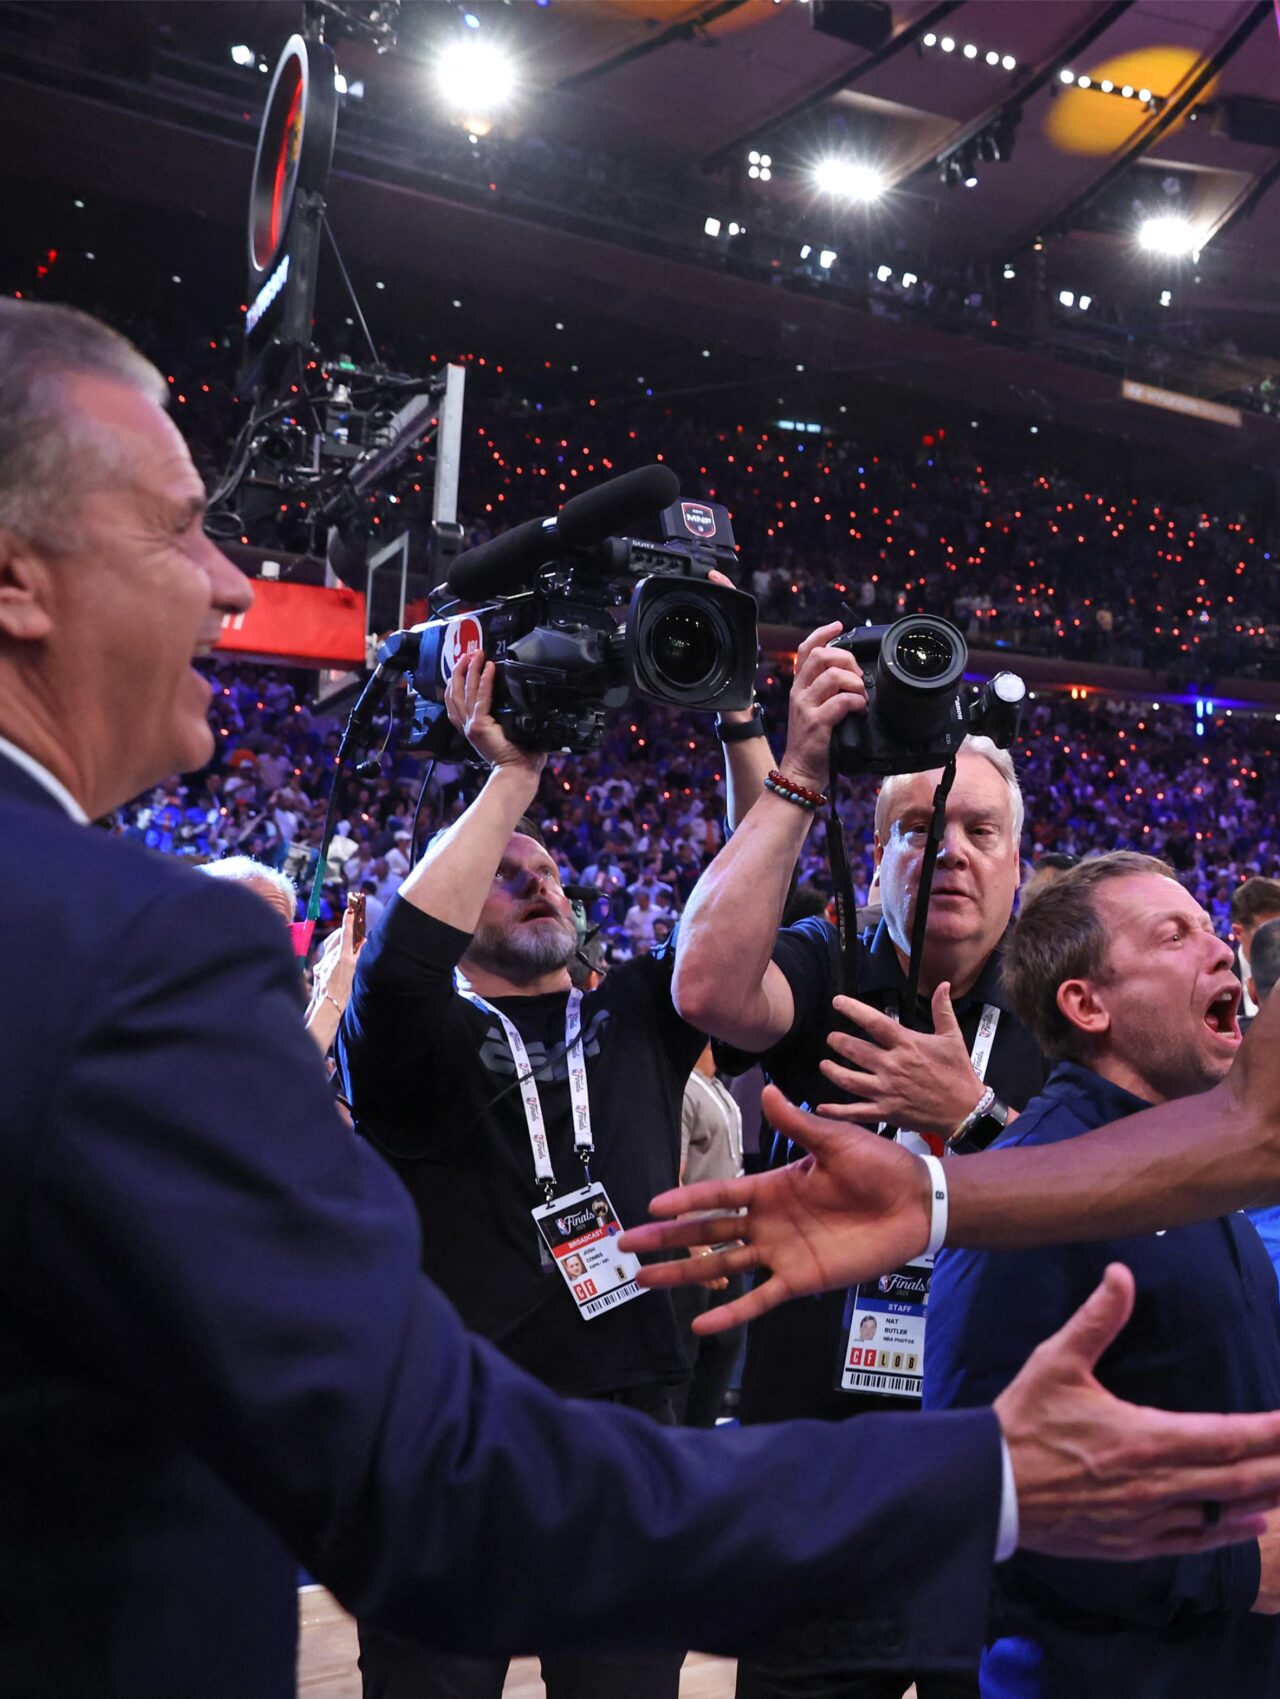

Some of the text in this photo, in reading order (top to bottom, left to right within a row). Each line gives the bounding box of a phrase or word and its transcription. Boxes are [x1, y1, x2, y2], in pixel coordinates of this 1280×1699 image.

[495, 640, 506, 655] 21
[936, 1190, 945, 1200] 8
[563, 1208, 596, 1235] Finals
[568, 1228, 603, 1249] BROADCAST
[576, 1281, 595, 1298] C F
[884, 1273, 926, 1293] Finals
[888, 1303, 912, 1313] STAFF
[884, 1327, 908, 1335] BUTLER
[852, 1350, 860, 1364] C
[866, 1352, 873, 1365] F
[881, 1354, 886, 1366] L
